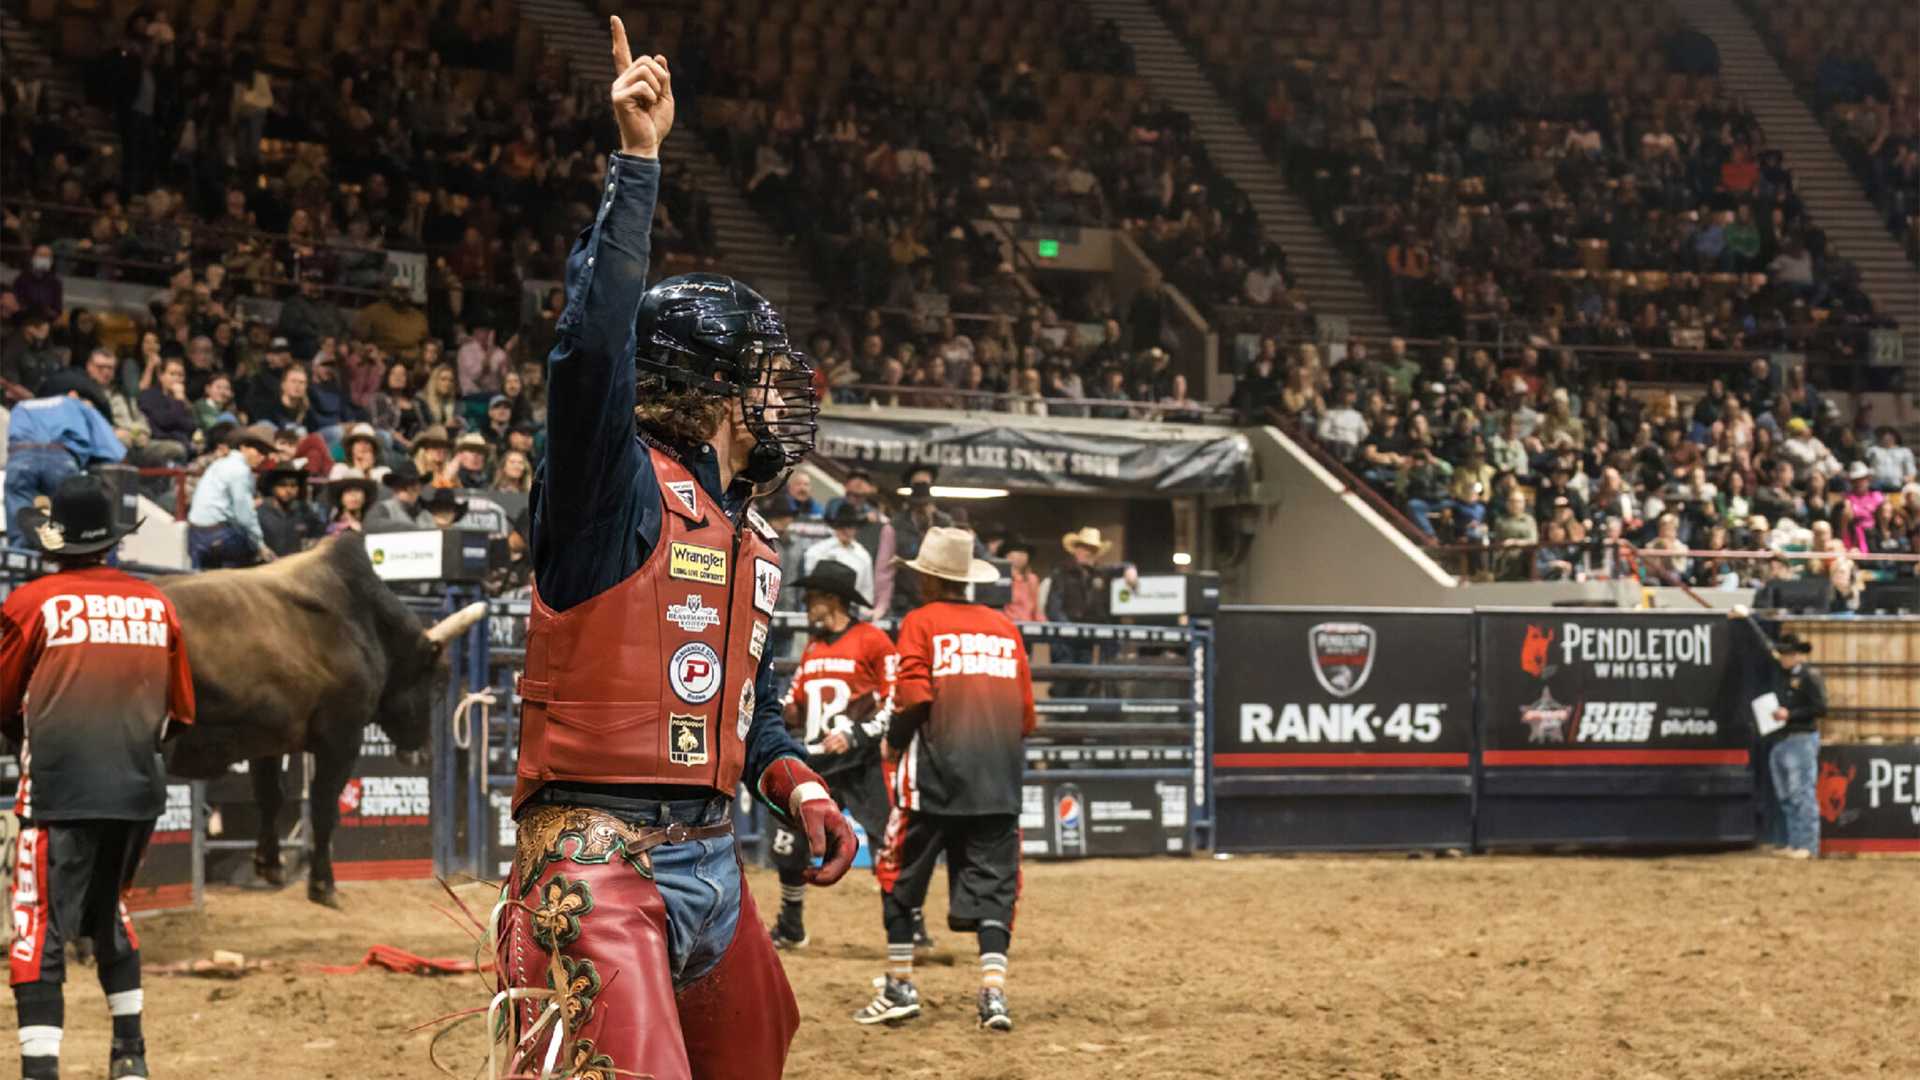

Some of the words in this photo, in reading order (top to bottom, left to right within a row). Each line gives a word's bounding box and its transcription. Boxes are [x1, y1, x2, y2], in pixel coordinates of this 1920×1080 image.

[673, 546, 724, 571] Wrangler
[84, 595, 165, 622] BOOT
[88, 619, 167, 648] BARN
[959, 633, 1017, 658] BOOT
[1561, 622, 1712, 665] PENDLETON
[683, 659, 710, 683] P
[961, 654, 1018, 679] BARN
[1594, 663, 1678, 679] WHISKY
[1584, 702, 1657, 721] RIDE
[1576, 720, 1653, 742] PASS
[1865, 758, 1920, 808] PE
